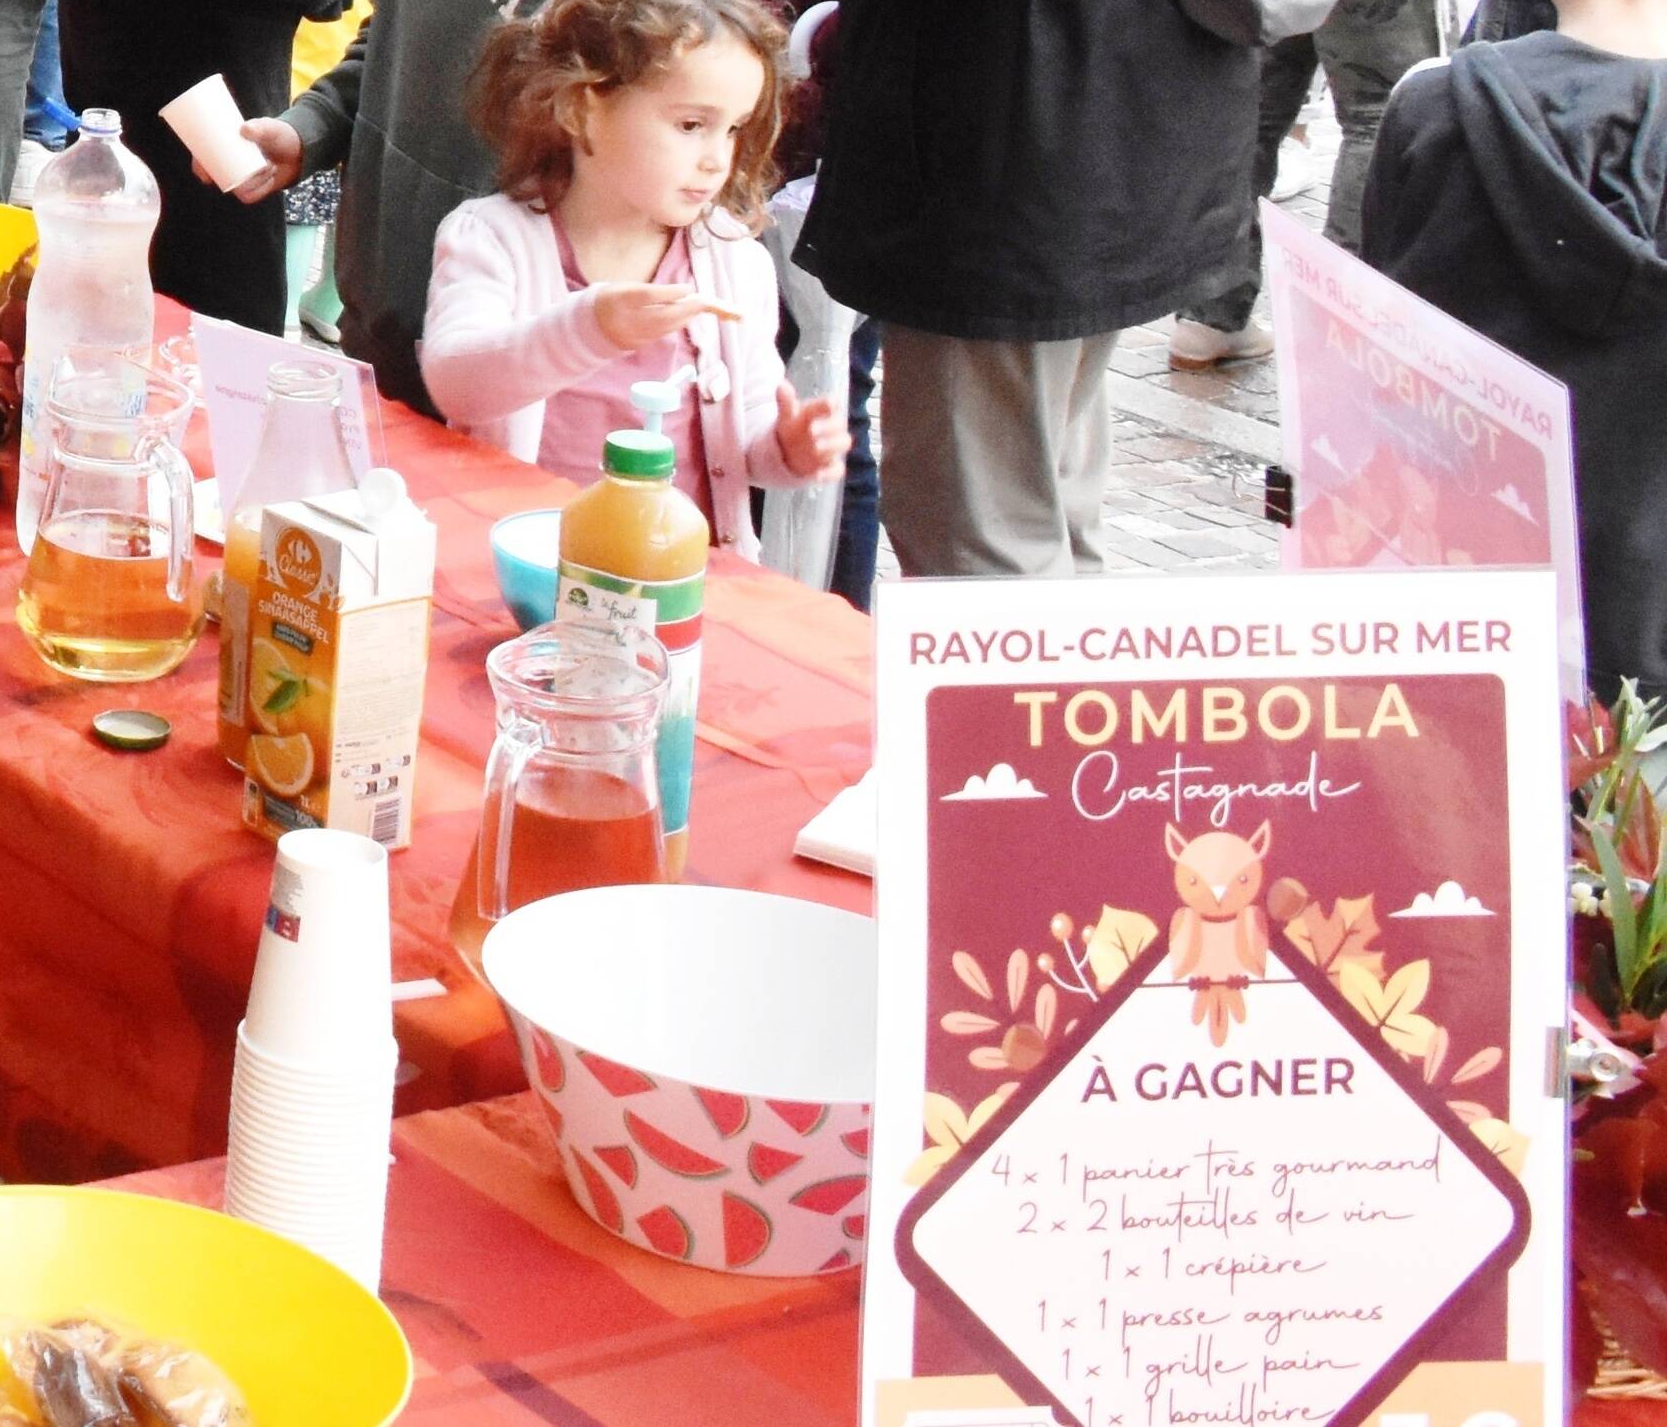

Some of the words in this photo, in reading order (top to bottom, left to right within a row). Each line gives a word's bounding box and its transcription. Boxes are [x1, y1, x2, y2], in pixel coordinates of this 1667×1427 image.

[273, 591, 318, 623] ORANGE
[909, 624, 1297, 665] RAYOL-CANADEL
[1311, 622, 1399, 655] SUR
[1416, 620, 1512, 653] MER
[1013, 683, 1420, 747] TOMBOLA
[1071, 750, 1361, 827] Castagnade
[1080, 1055, 1117, 1103] À
[1135, 1057, 1355, 1101] GAGNER
[991, 1154, 1010, 1186] 4
[1060, 1153, 1068, 1185] 1
[1083, 1159, 1190, 1203] panier
[1194, 1139, 1255, 1194] très
[1272, 1134, 1441, 1197] gourmand
[1016, 1202, 1037, 1234] 2
[1087, 1199, 1107, 1232] 2
[1122, 1186, 1257, 1243] bouteilles
[1276, 1187, 1330, 1236] de
[1344, 1201, 1414, 1222] vin
[1102, 1249, 1110, 1281] 1
[1162, 1247, 1170, 1279] 1
[1185, 1253, 1327, 1296] crépière
[1038, 1299, 1046, 1332] 1
[1099, 1298, 1107, 1330] 1
[1122, 1308, 1230, 1348] presse
[1244, 1305, 1383, 1346] agrumes
[1062, 1348, 1070, 1380] 1
[1123, 1346, 1130, 1378] 1
[1144, 1334, 1248, 1398] grille
[1263, 1350, 1361, 1393] pain
[1085, 1396, 1093, 1427] 1
[1146, 1395, 1153, 1426] 1
[1169, 1382, 1335, 1427] bouilloire
